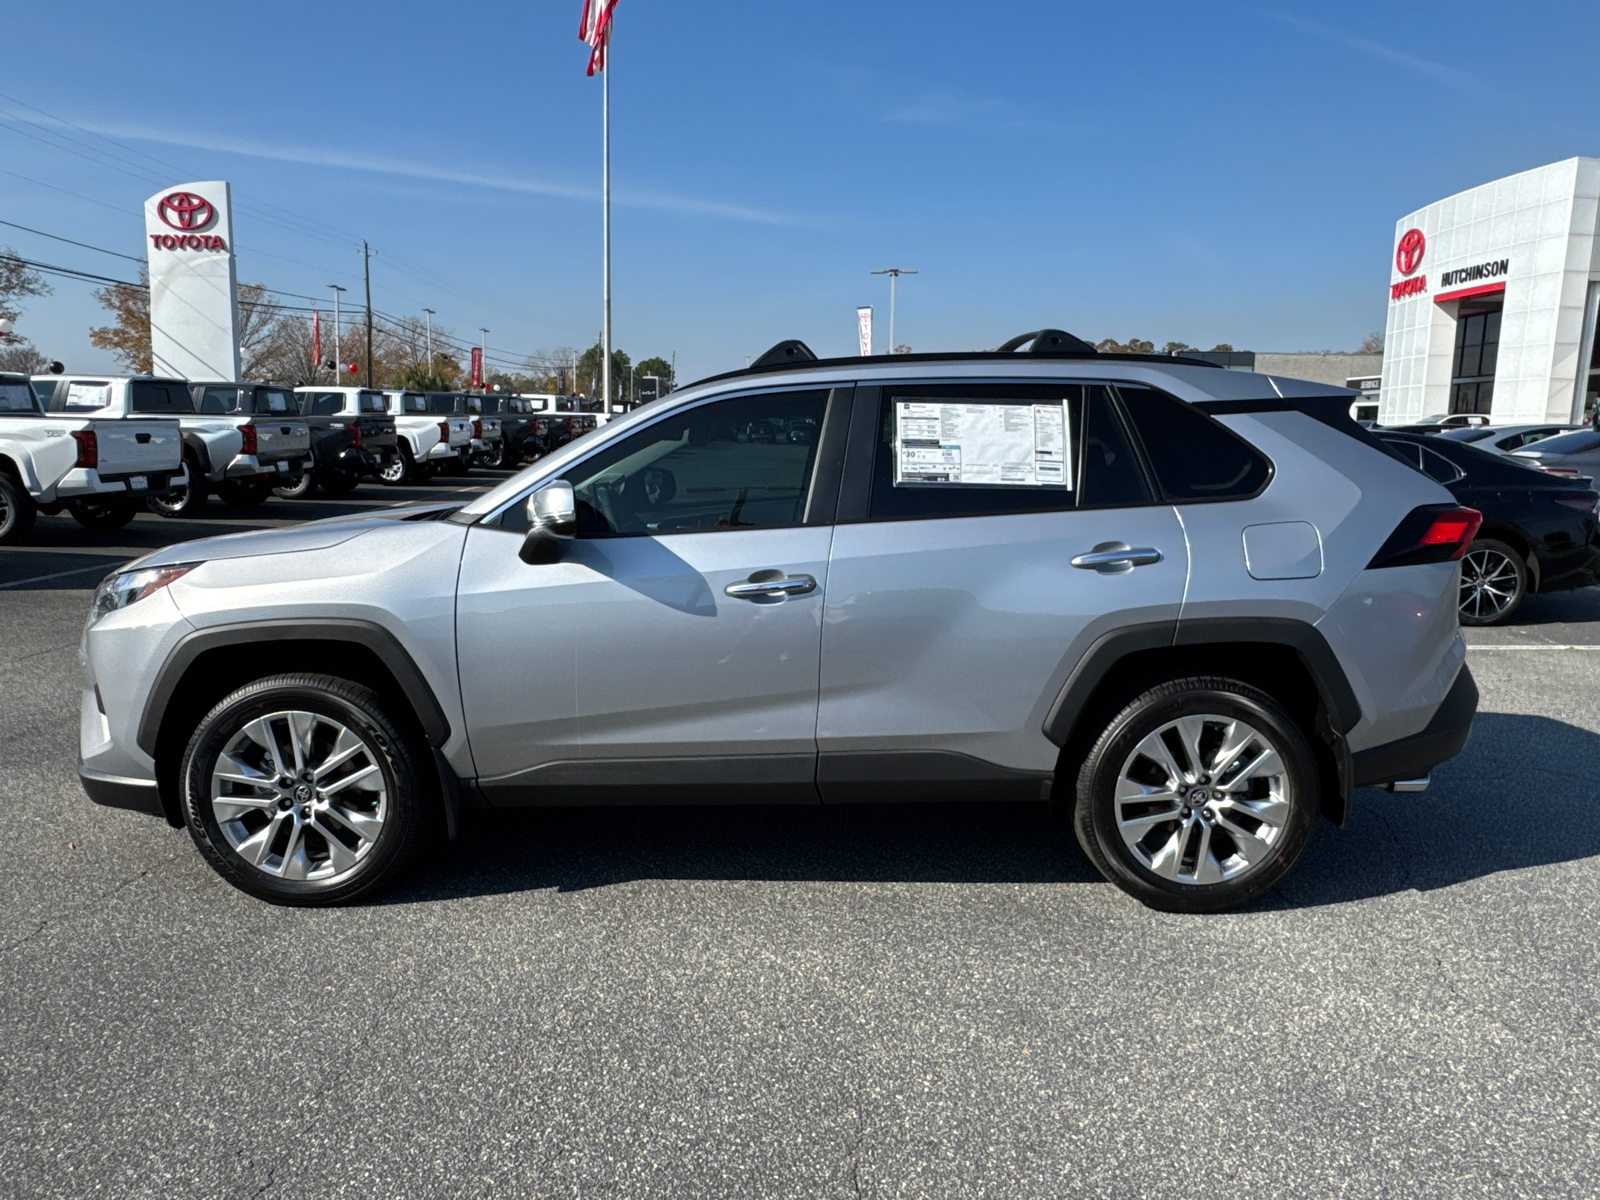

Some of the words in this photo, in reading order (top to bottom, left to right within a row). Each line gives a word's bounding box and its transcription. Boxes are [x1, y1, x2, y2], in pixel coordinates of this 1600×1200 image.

[150, 234, 225, 250] TOYOTA
[1441, 259, 1509, 287] HUTCHINSON
[1390, 275, 1427, 299] TOYOTA
